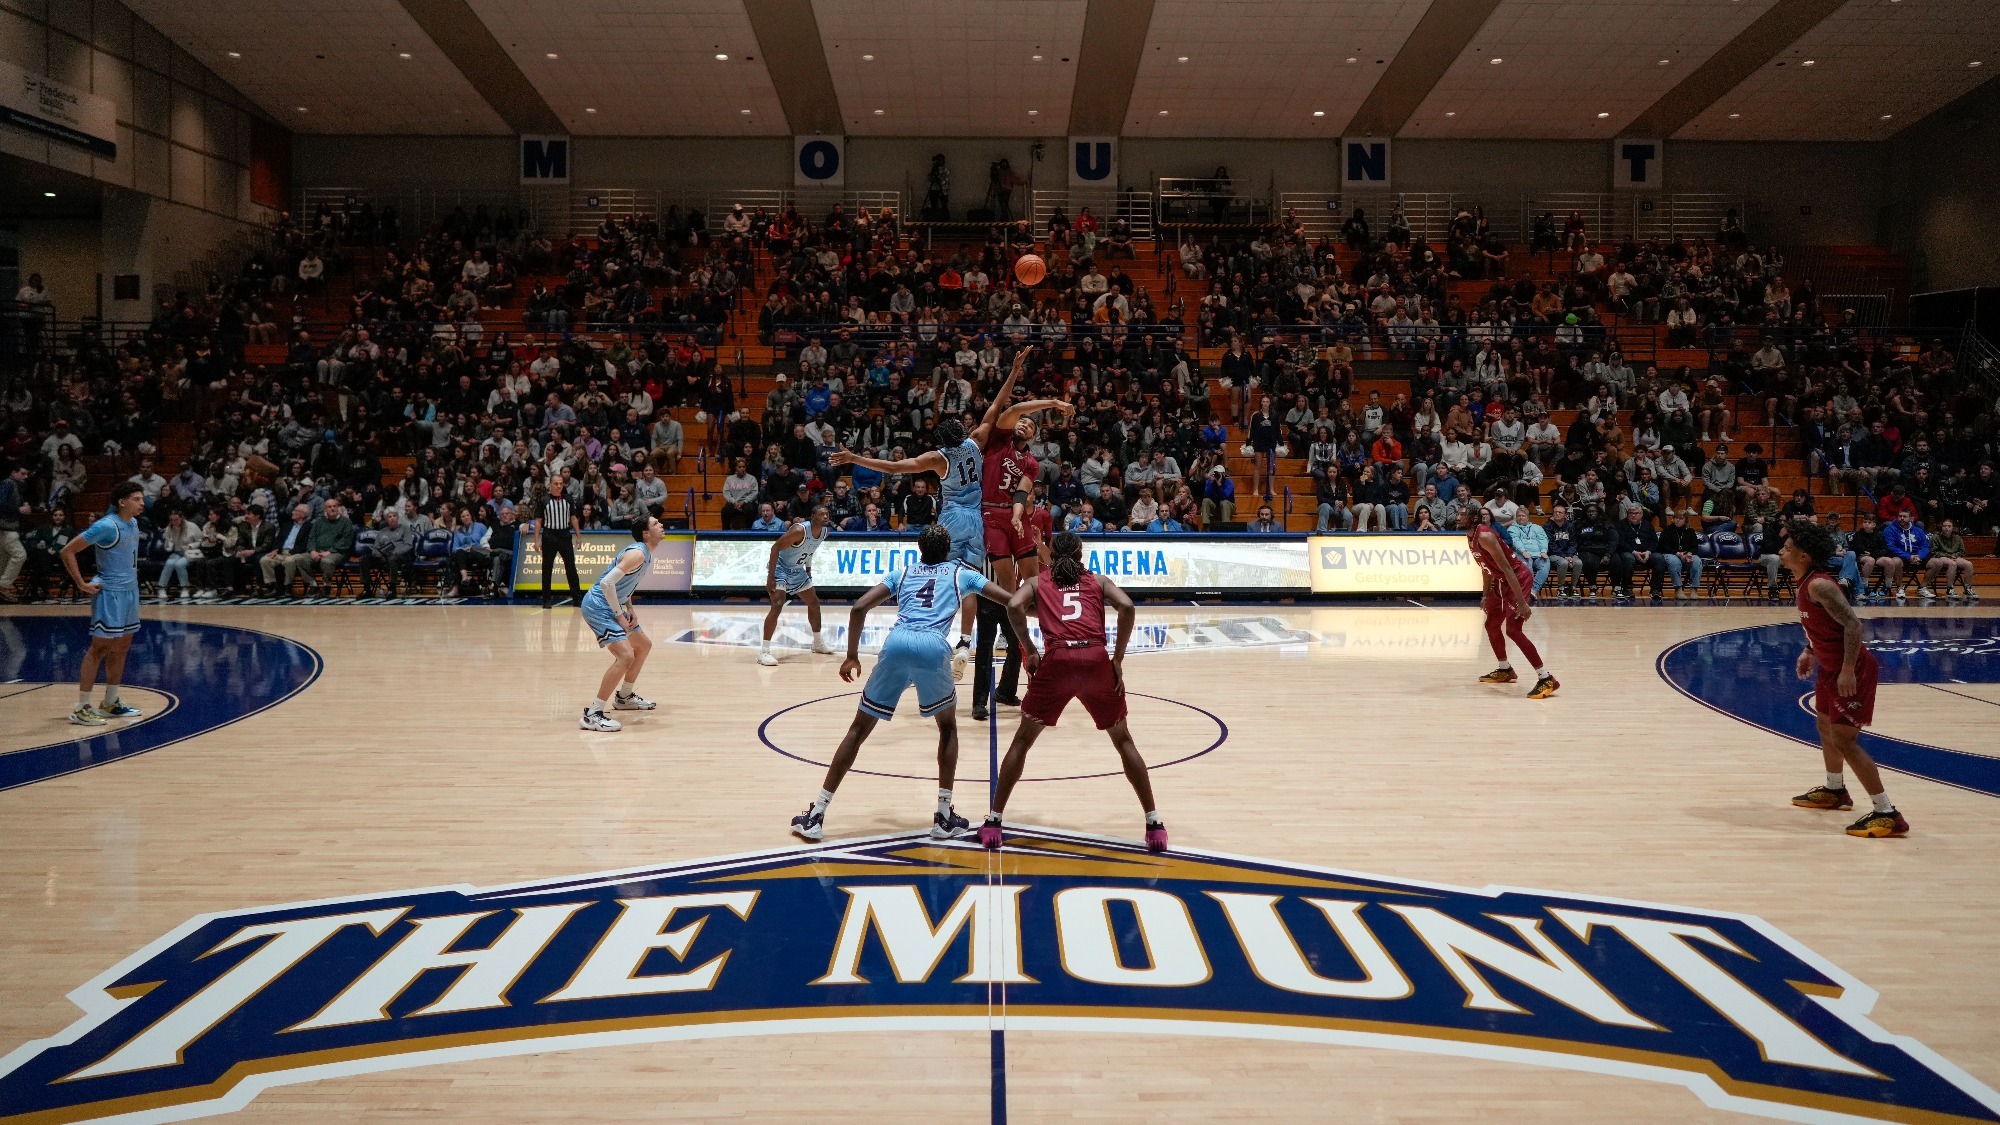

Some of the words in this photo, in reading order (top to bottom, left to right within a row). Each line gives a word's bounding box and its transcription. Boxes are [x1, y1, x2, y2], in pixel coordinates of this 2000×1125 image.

[524, 140, 566, 178] M
[800, 141, 839, 180] O
[1076, 142, 1111, 180] U
[1348, 144, 1385, 180] N
[1623, 145, 1654, 181] T
[956, 456, 979, 487] 12
[1002, 457, 1025, 478] RIDE
[524, 554, 567, 564] Athte
[577, 542, 616, 552] Mount
[1352, 549, 1471, 566] WYNDHAM
[522, 567, 533, 575] On
[836, 549, 918, 575] WELCO
[1088, 550, 1168, 576] ARENA
[1355, 572, 1430, 585] Gettysburg
[915, 578, 937, 608] 4
[1062, 592, 1082, 621] 5
[47, 887, 763, 1086] THE
[807, 883, 1896, 1081] MOUNT
